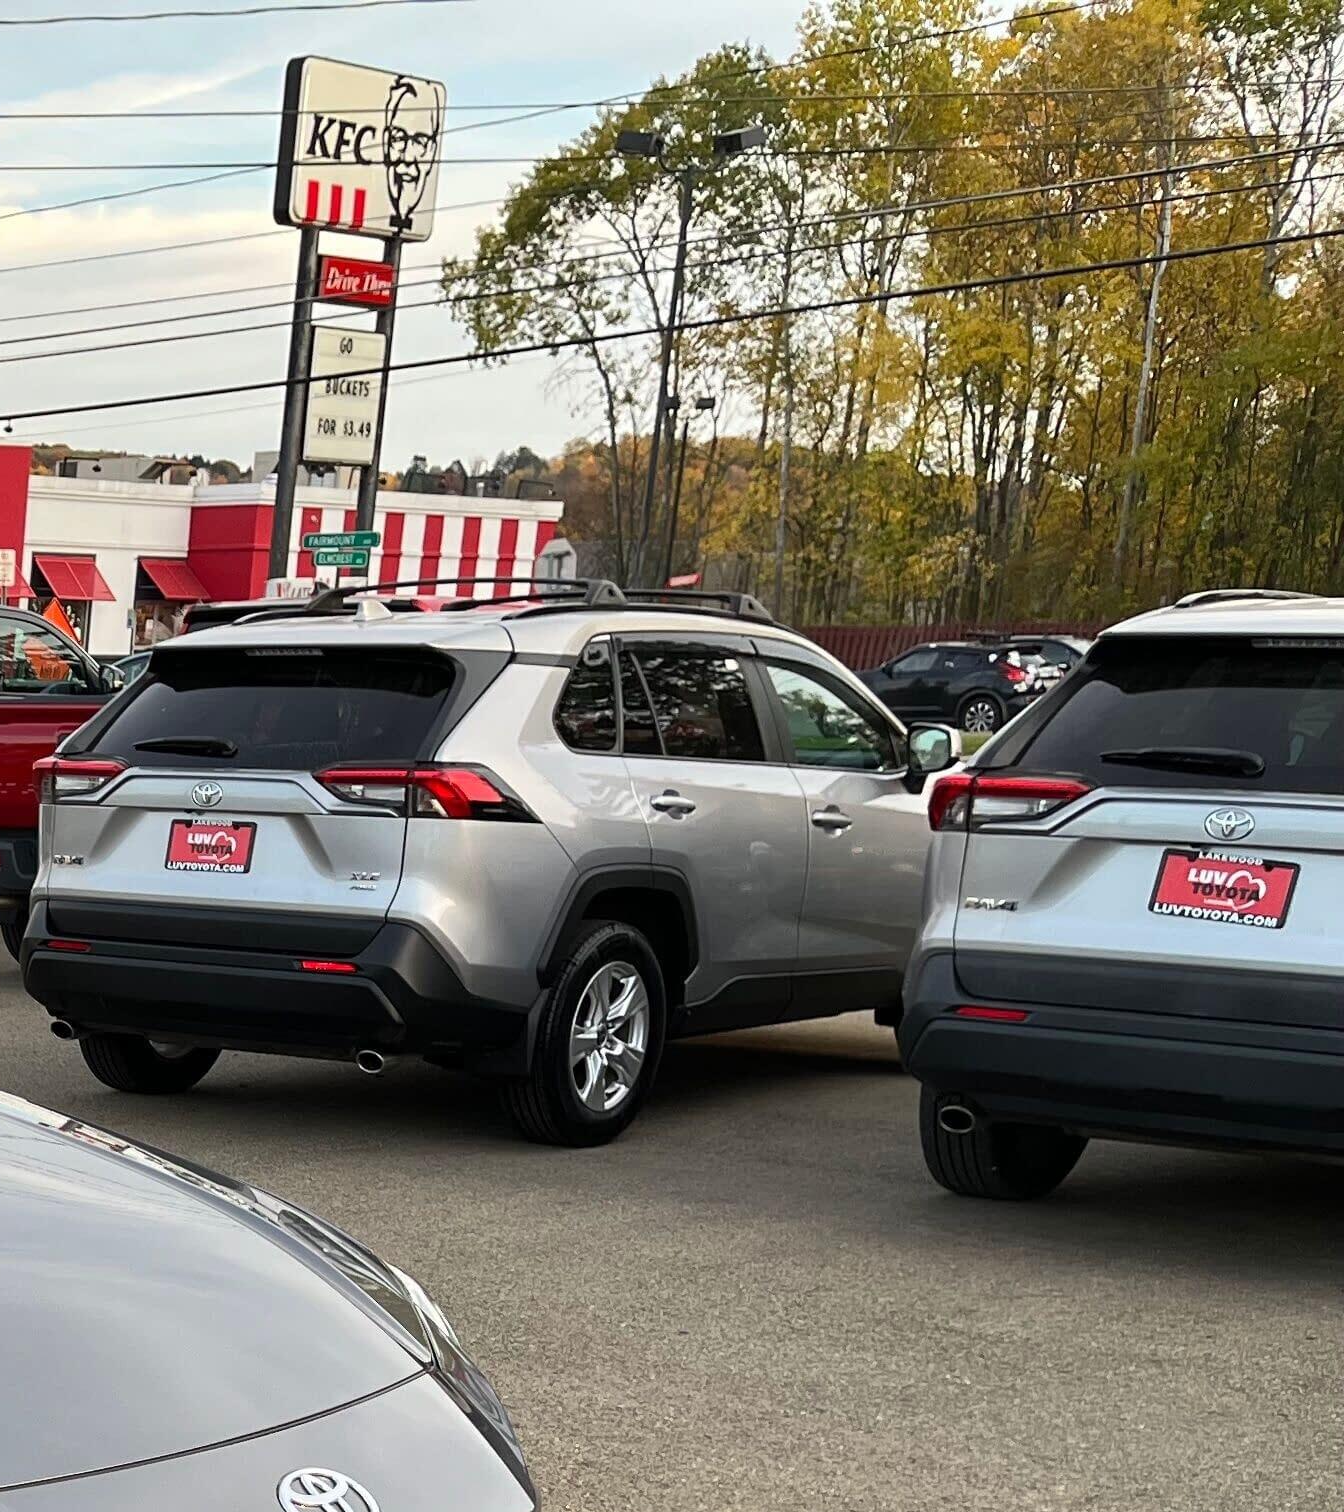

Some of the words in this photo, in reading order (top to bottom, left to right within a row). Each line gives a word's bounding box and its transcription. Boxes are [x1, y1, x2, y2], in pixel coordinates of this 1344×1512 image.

[306, 113, 377, 164] KFC
[326, 266, 361, 293] Drive
[325, 378, 370, 397] BUCKETS
[317, 418, 337, 436] FOR
[308, 535, 356, 547] FAIRMOUNT
[187, 832, 213, 845] LUV
[191, 843, 233, 855] TOYOTA
[167, 861, 245, 873] LUVTOYOTA.COM
[1198, 851, 1264, 866] LAKEWOOD
[1187, 868, 1229, 886] LUV
[1192, 882, 1260, 901] TOYOTA
[1153, 902, 1278, 928] LUVTOYOTA.COM
